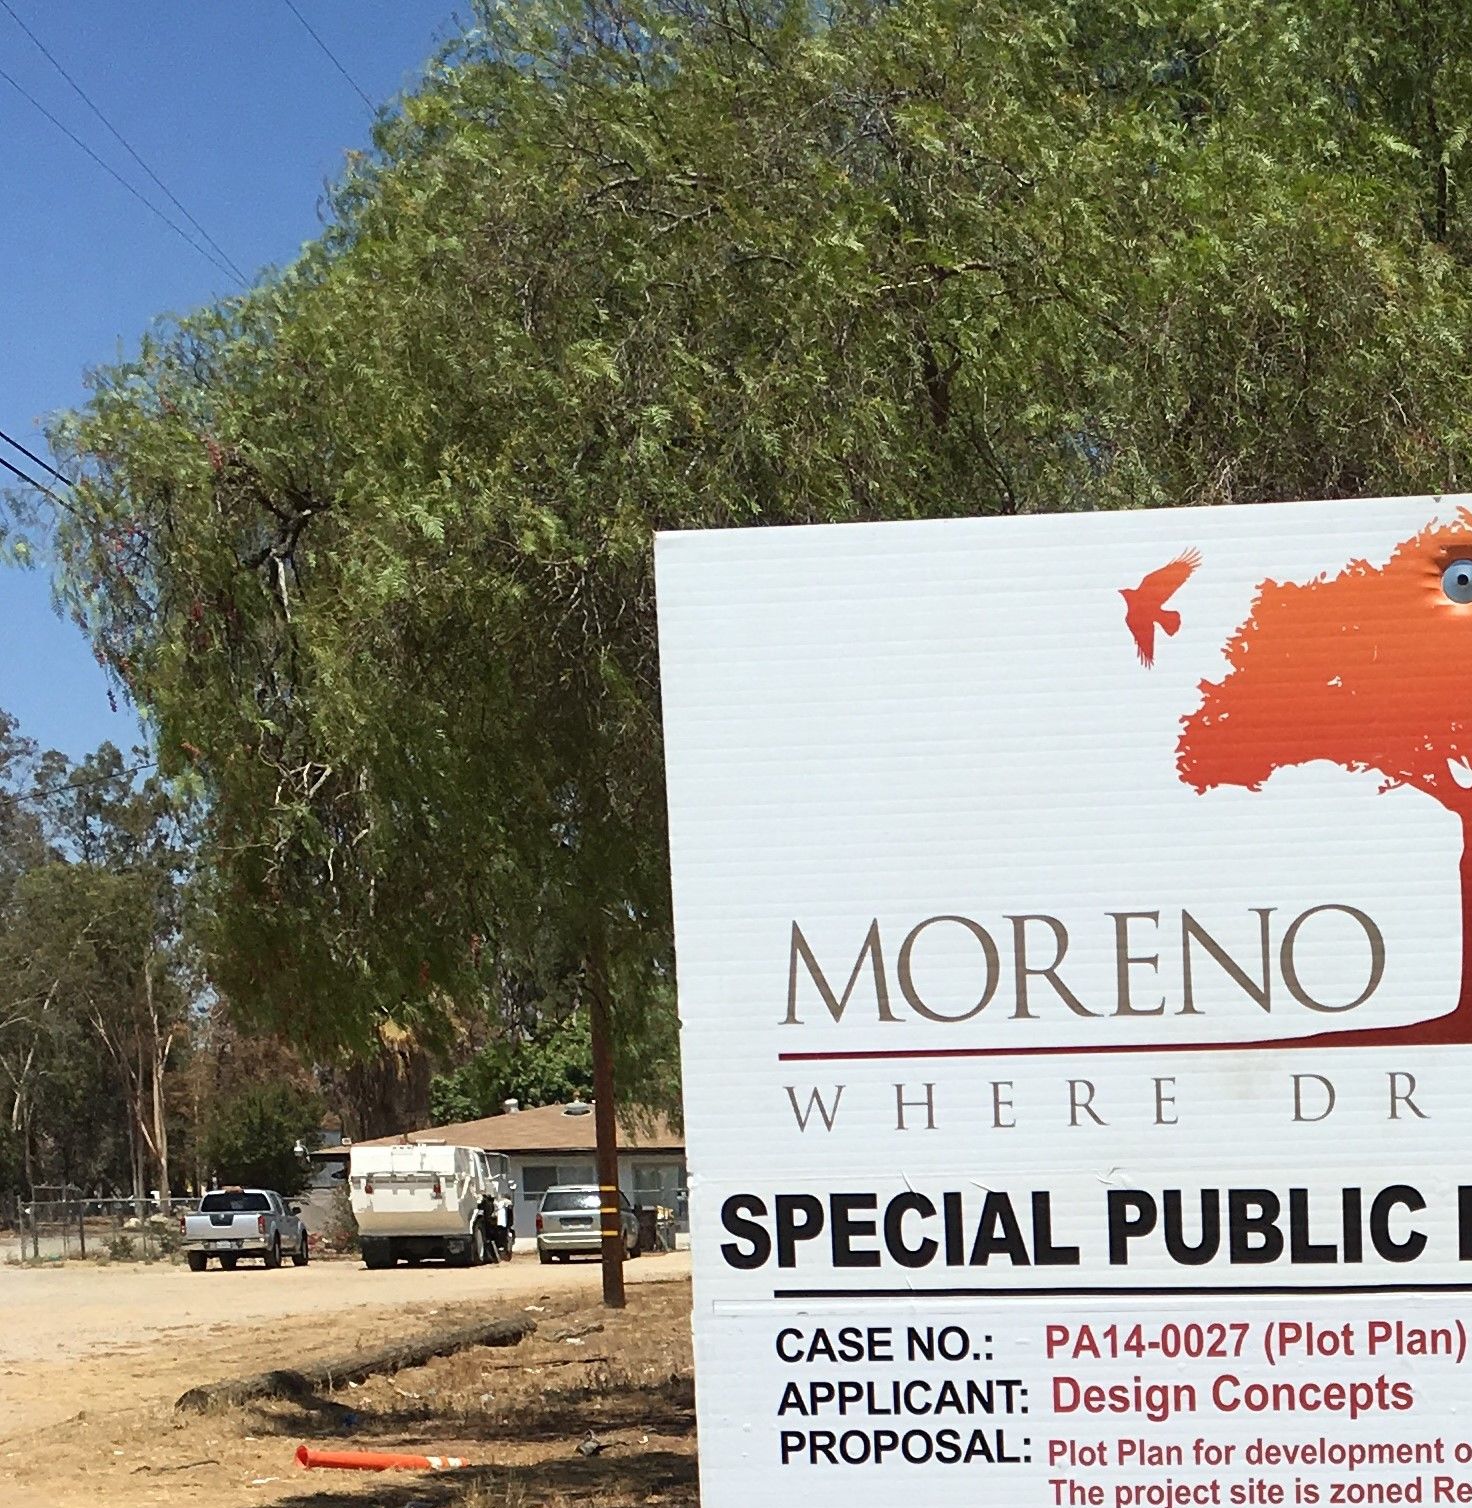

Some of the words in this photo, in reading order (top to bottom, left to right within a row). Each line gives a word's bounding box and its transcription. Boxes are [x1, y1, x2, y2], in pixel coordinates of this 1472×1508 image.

[777, 903, 1386, 1026] MORENO
[783, 1076, 1179, 1133] WHERE
[720, 1189, 1080, 1270] SPECIAL
[1106, 1184, 1428, 1266] PUBLIC
[775, 1326, 894, 1363] CASE
[906, 1325, 993, 1362] NO.:
[1045, 1322, 1250, 1360] PA14-0027
[1264, 1321, 1355, 1366] (Plot
[1367, 1319, 1467, 1364] Plan)
[777, 1379, 1029, 1417] APPLICANT:
[1052, 1375, 1197, 1423] Design
[1212, 1373, 1414, 1420] Concepts
[780, 1428, 1032, 1465] PROPOSAL:
[1048, 1439, 1108, 1467] Plot
[1117, 1438, 1183, 1467] Plan
[1192, 1437, 1237, 1466] for
[1245, 1437, 1445, 1472] development
[1047, 1478, 1105, 1506] The
[1229, 1477, 1285, 1505] site
[1295, 1477, 1320, 1505] is
[1329, 1476, 1423, 1504] zoned
